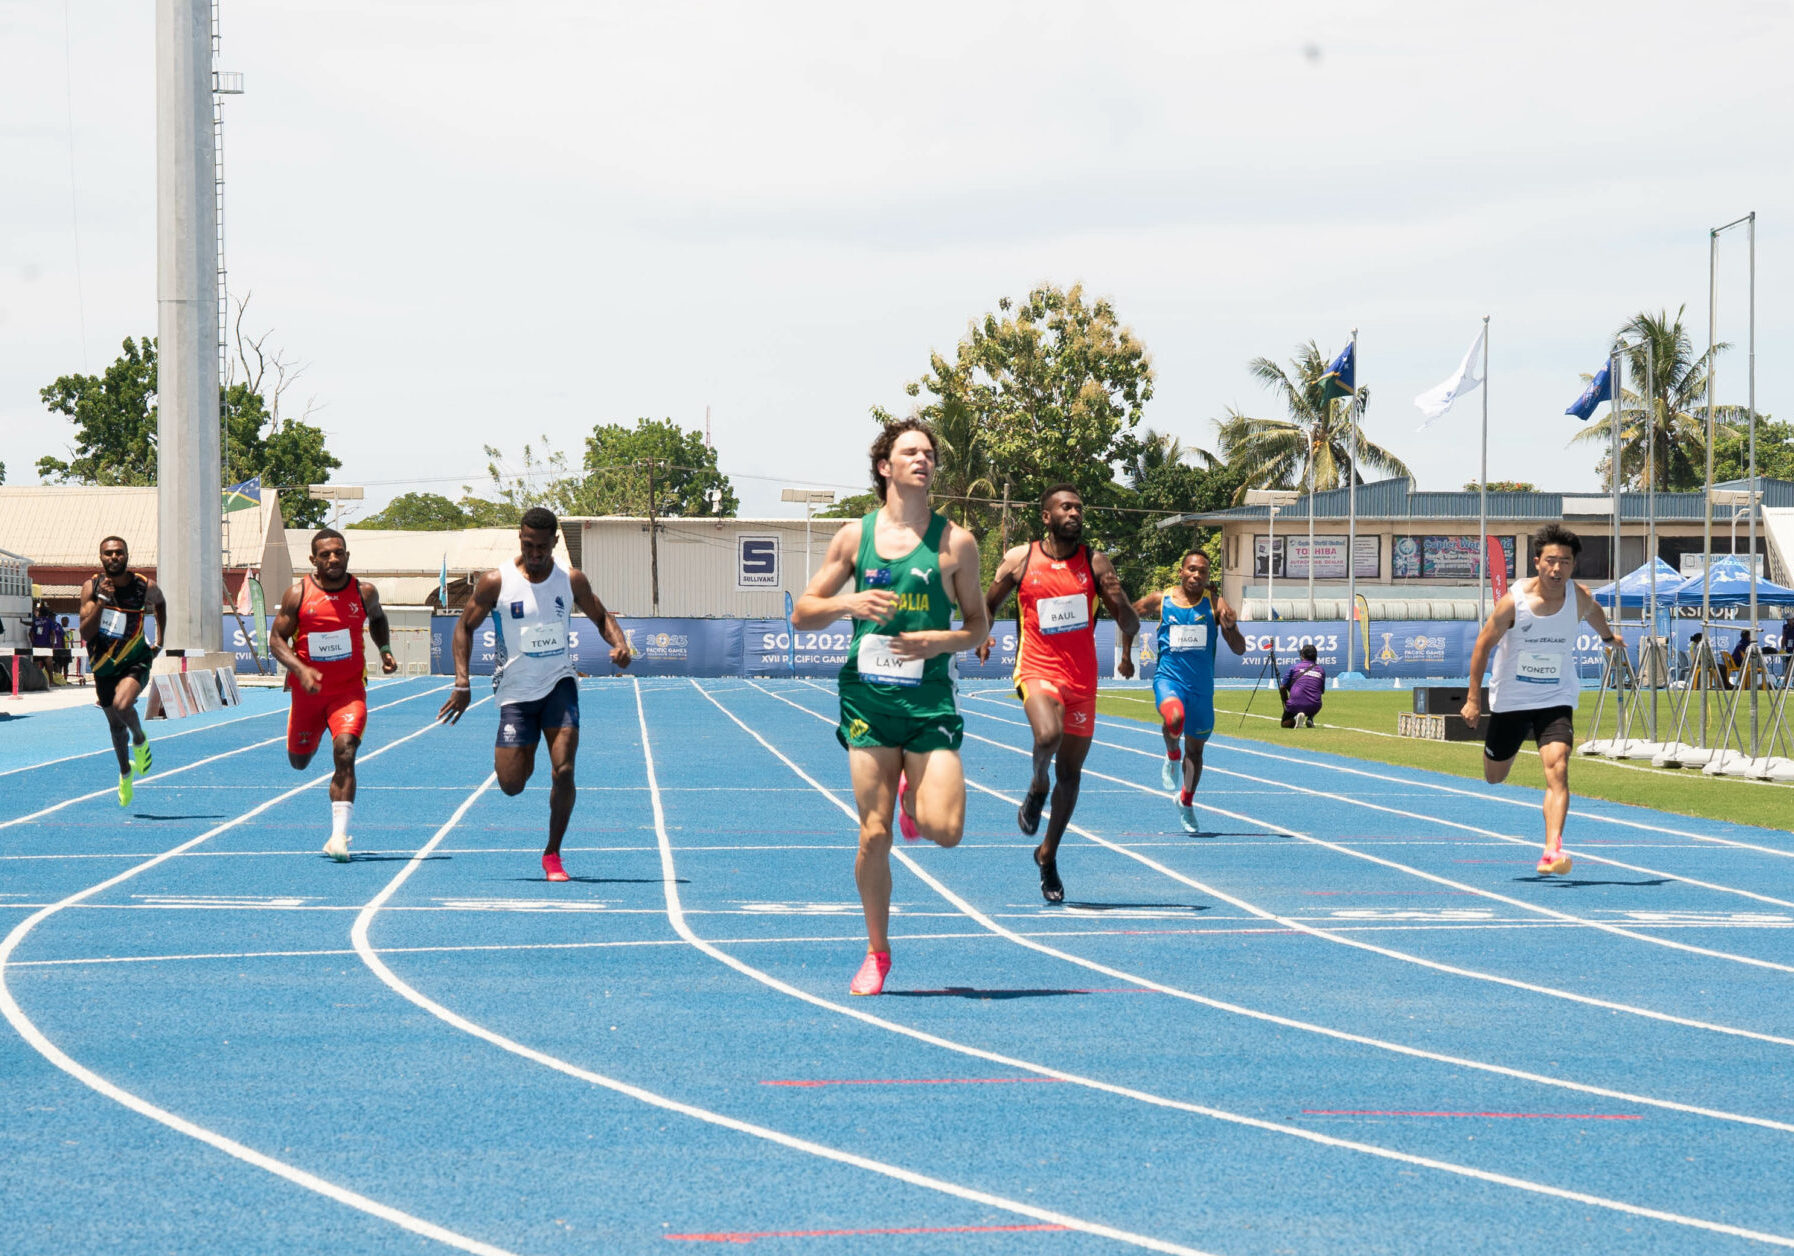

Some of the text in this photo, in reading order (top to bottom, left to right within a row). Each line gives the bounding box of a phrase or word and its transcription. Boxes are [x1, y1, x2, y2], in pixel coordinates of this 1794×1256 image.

[1051, 611, 1076, 622] BAUL
[531, 638, 557, 648] TEWA
[319, 644, 342, 652] WISIL
[762, 655, 780, 663] XVII
[783, 655, 820, 664] PCIFIC
[876, 657, 904, 668] LAW
[1242, 657, 1260, 665] XVII
[1521, 665, 1557, 674] YONETO
